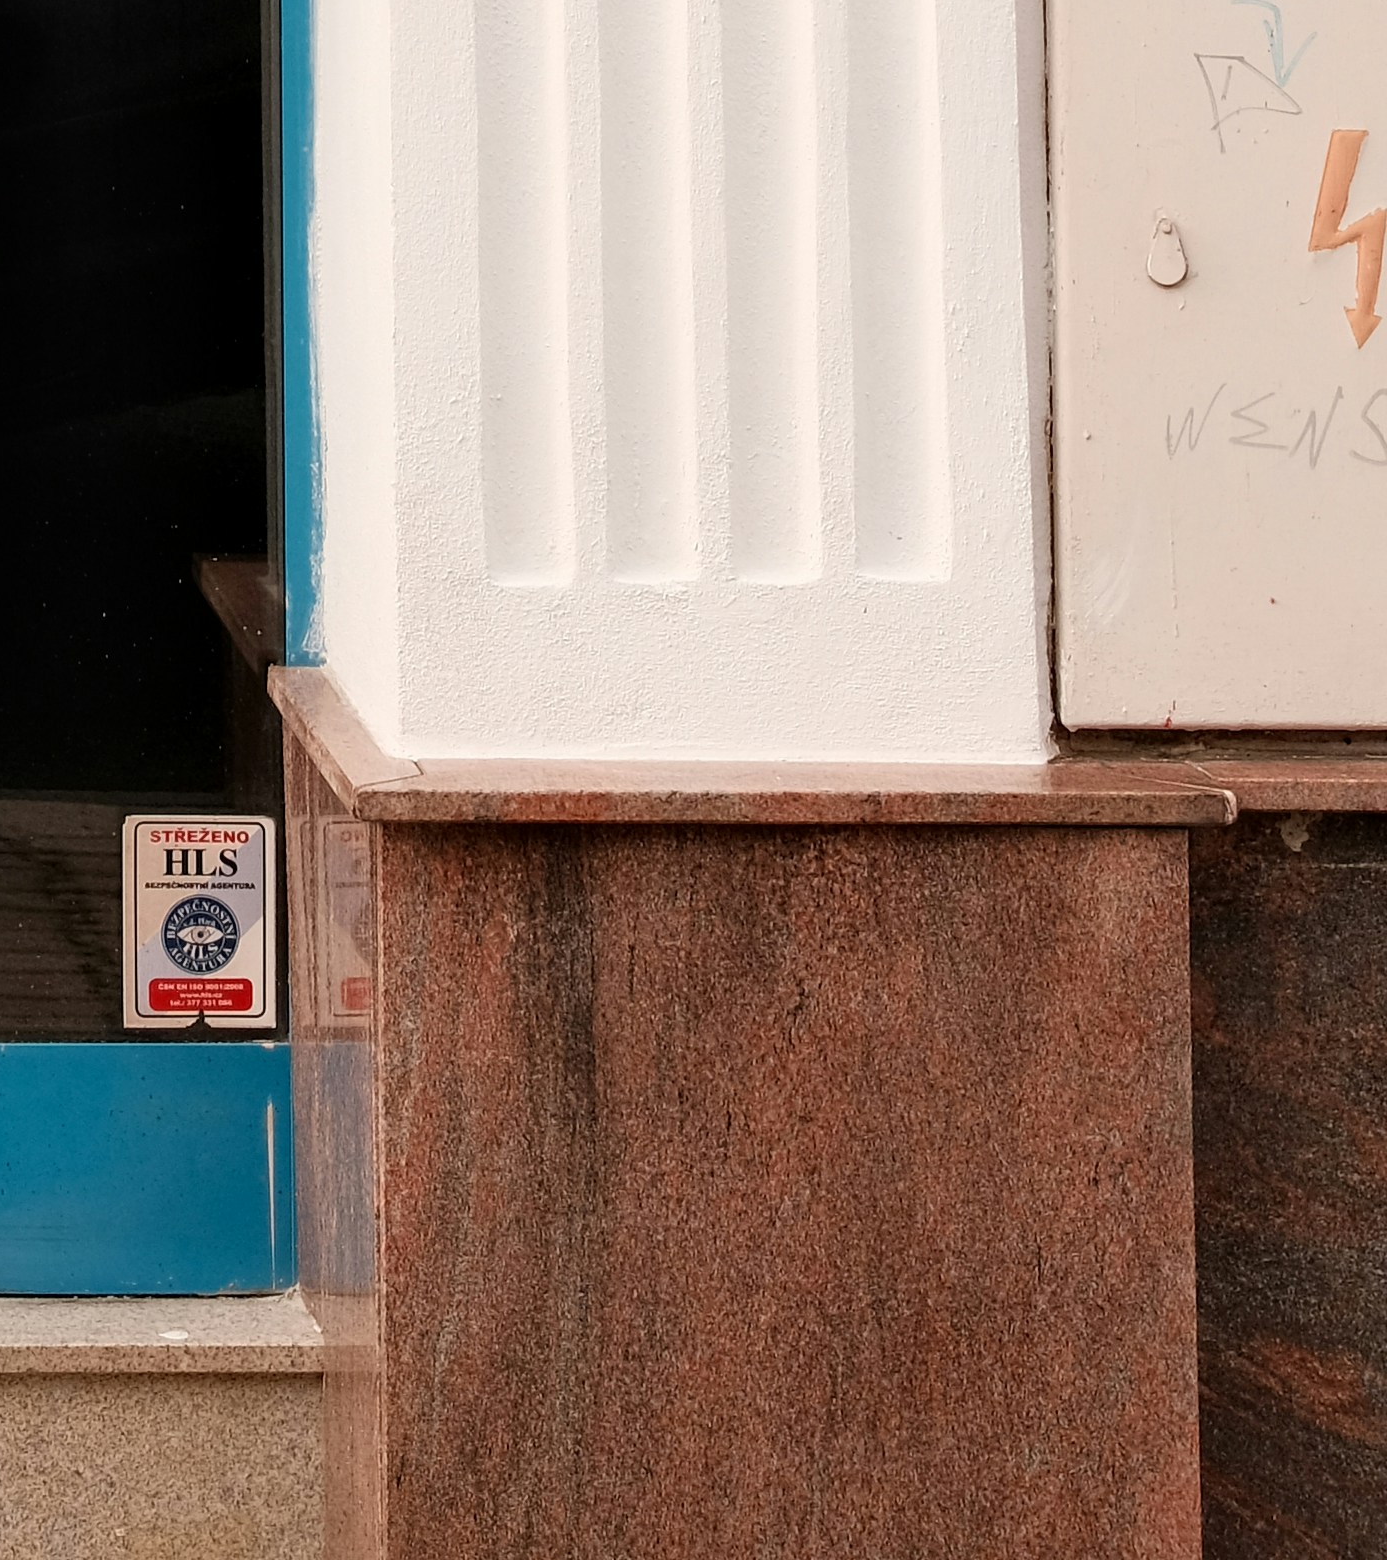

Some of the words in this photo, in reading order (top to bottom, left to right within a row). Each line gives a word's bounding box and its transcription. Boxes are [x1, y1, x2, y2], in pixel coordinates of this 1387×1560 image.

[150, 827, 249, 844] STŘEŽENO
[163, 848, 238, 877] HLS
[144, 881, 209, 889] BEZPEČNOSTNÍ
[167, 899, 237, 939] BEZPEČNOSTNÍ
[169, 947, 232, 971] AGENTURA
[183, 943, 219, 960] HLS
[189, 983, 203, 991] ISO
